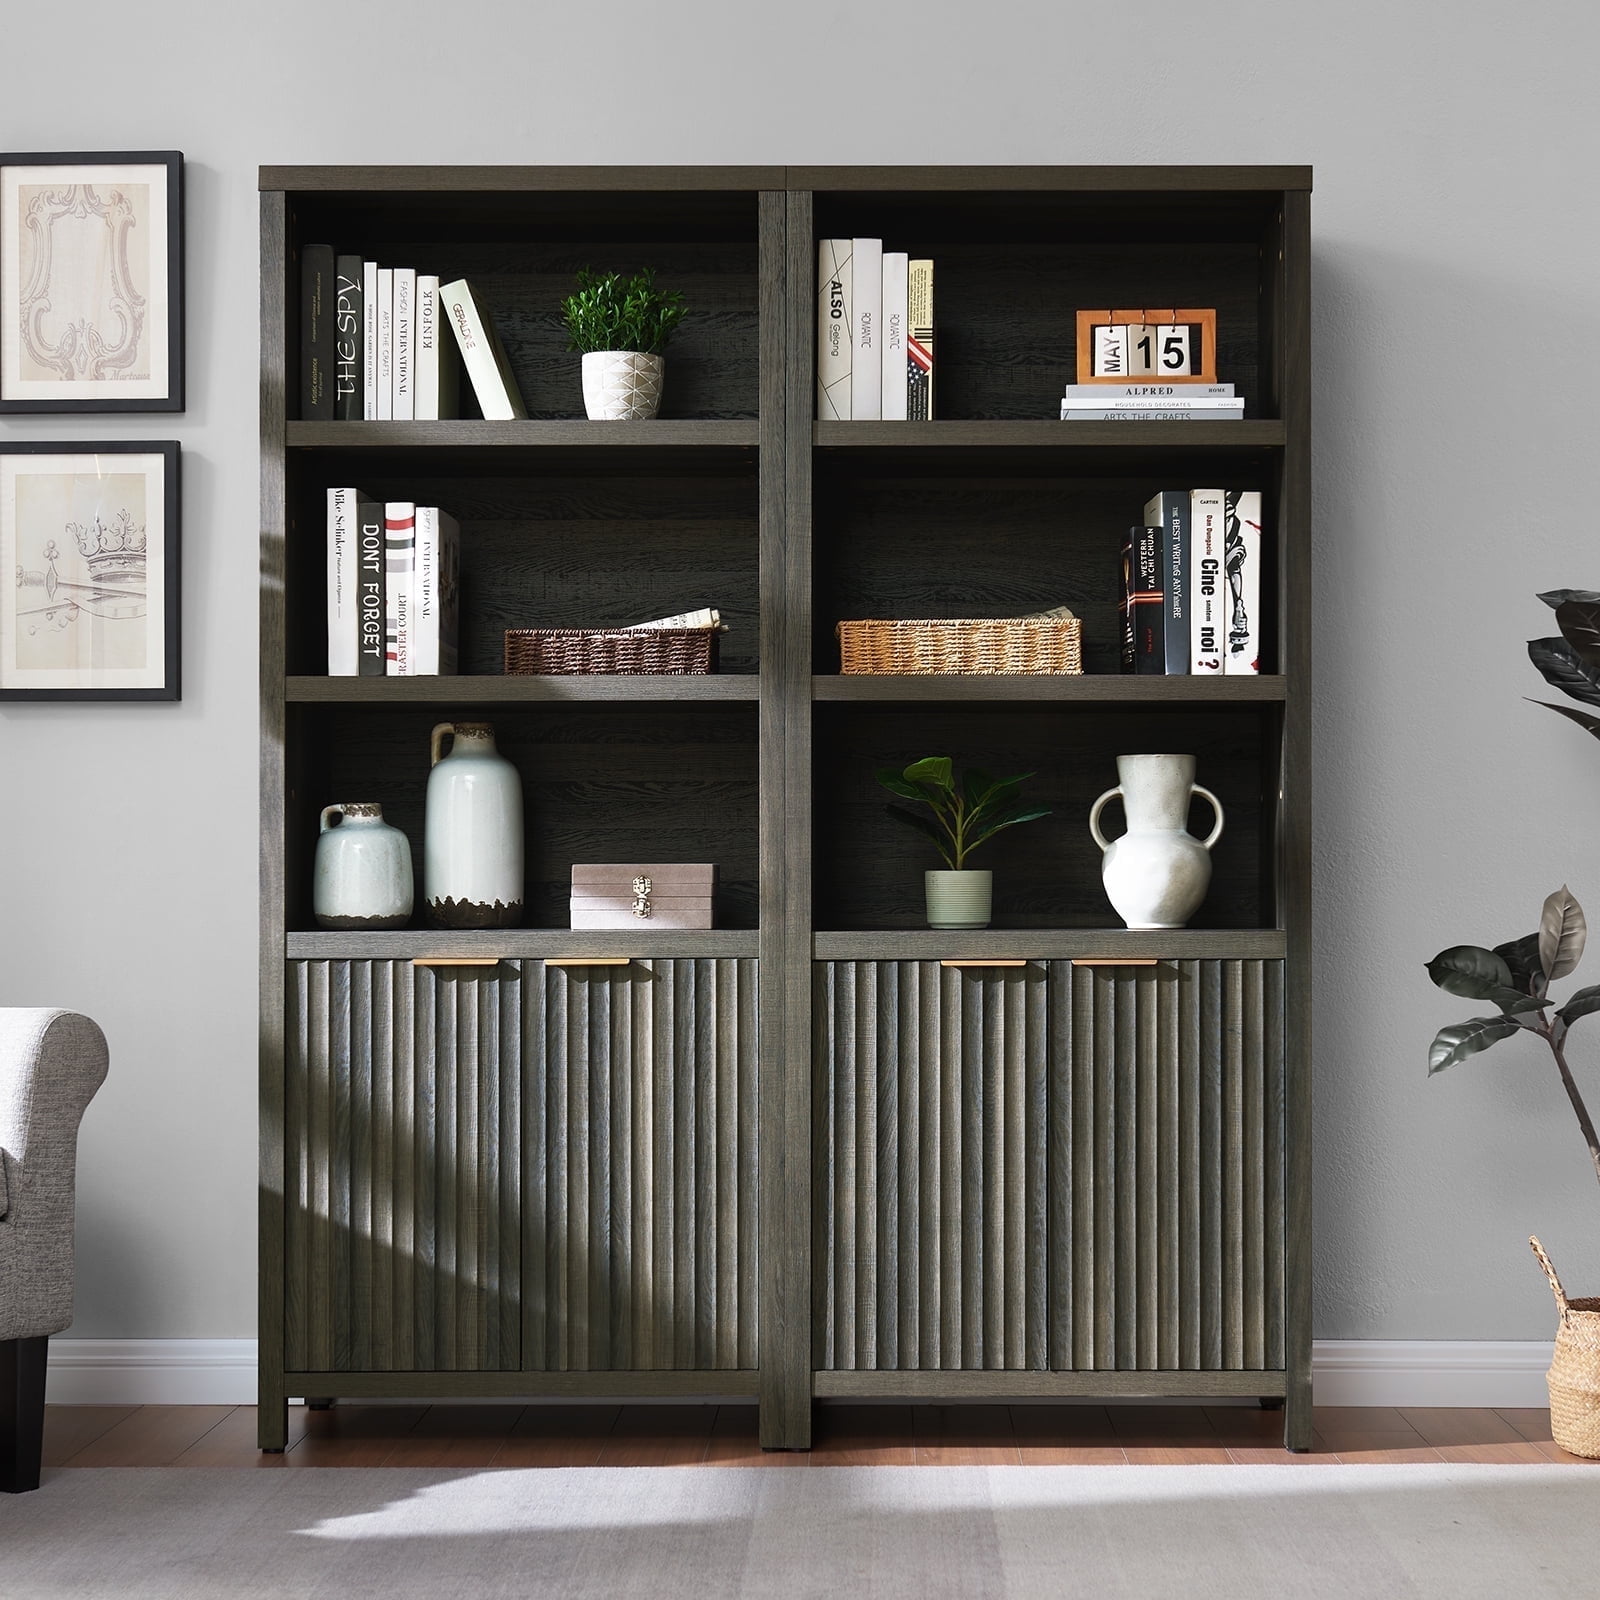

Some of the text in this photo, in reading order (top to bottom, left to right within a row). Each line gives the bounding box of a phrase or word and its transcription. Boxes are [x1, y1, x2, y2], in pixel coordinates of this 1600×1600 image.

[337, 275, 361, 335] SPY
[423, 290, 433, 349] KINFOLK
[831, 281, 842, 357] ALSO Gelang
[399, 281, 408, 396] FASHION INTERNATIONAL
[452, 303, 476, 350] GERALDINE
[1104, 337, 1121, 373] MAY
[1126, 387, 1174, 396] ALPRED
[1103, 412, 1191, 420] ARTS THE CRAFTS
[335, 515, 346, 557] Selinker
[1172, 519, 1181, 542] BEST
[1140, 539, 1148, 577] WESTERN
[1148, 559, 1156, 573] CHI
[362, 523, 381, 658] DONT FORGET
[422, 541, 431, 619] INTERNATIONAL
[1148, 576, 1156, 590] TAI
[1201, 559, 1218, 596] Cine
[398, 593, 407, 628] COURT
[1201, 626, 1218, 653] noi
